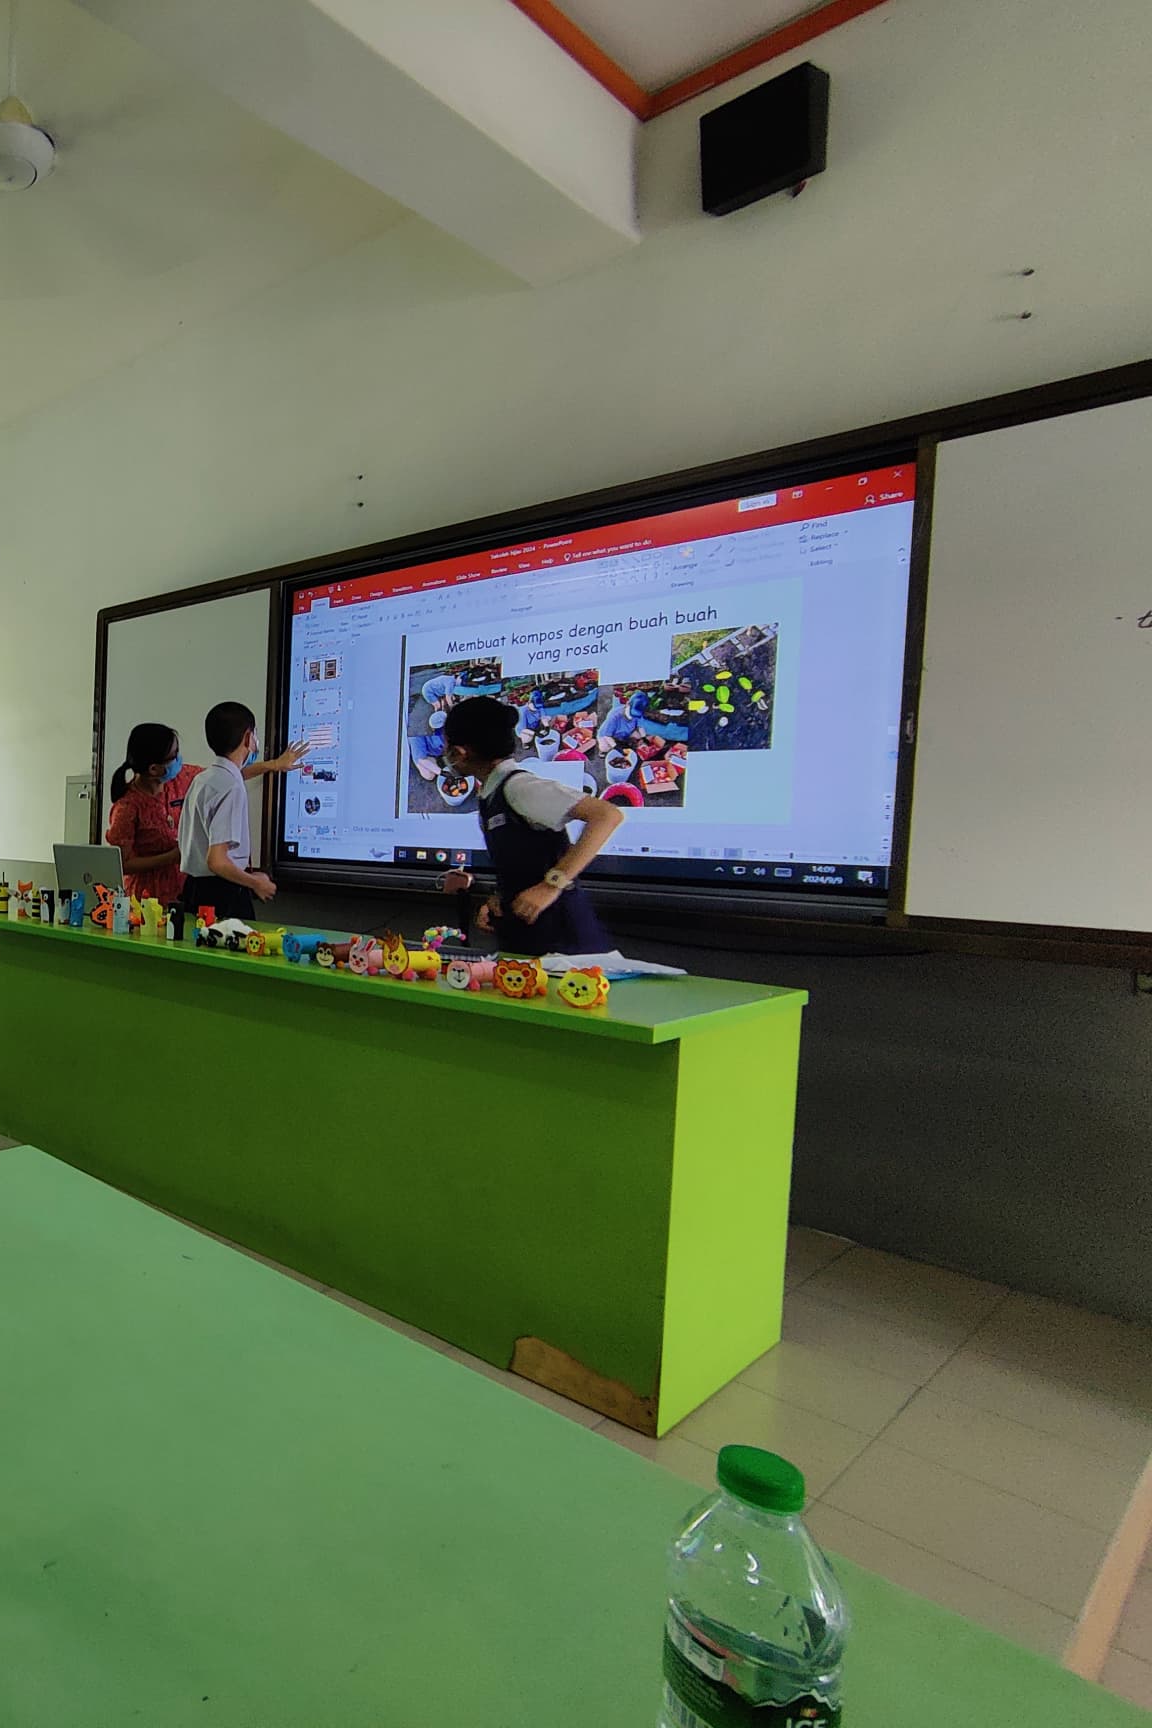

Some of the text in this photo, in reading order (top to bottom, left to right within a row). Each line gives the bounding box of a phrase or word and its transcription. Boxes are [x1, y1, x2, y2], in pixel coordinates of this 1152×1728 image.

[446, 606, 718, 655] Membuat kompos dengan buah buah
[528, 639, 609, 665] yang rosak
